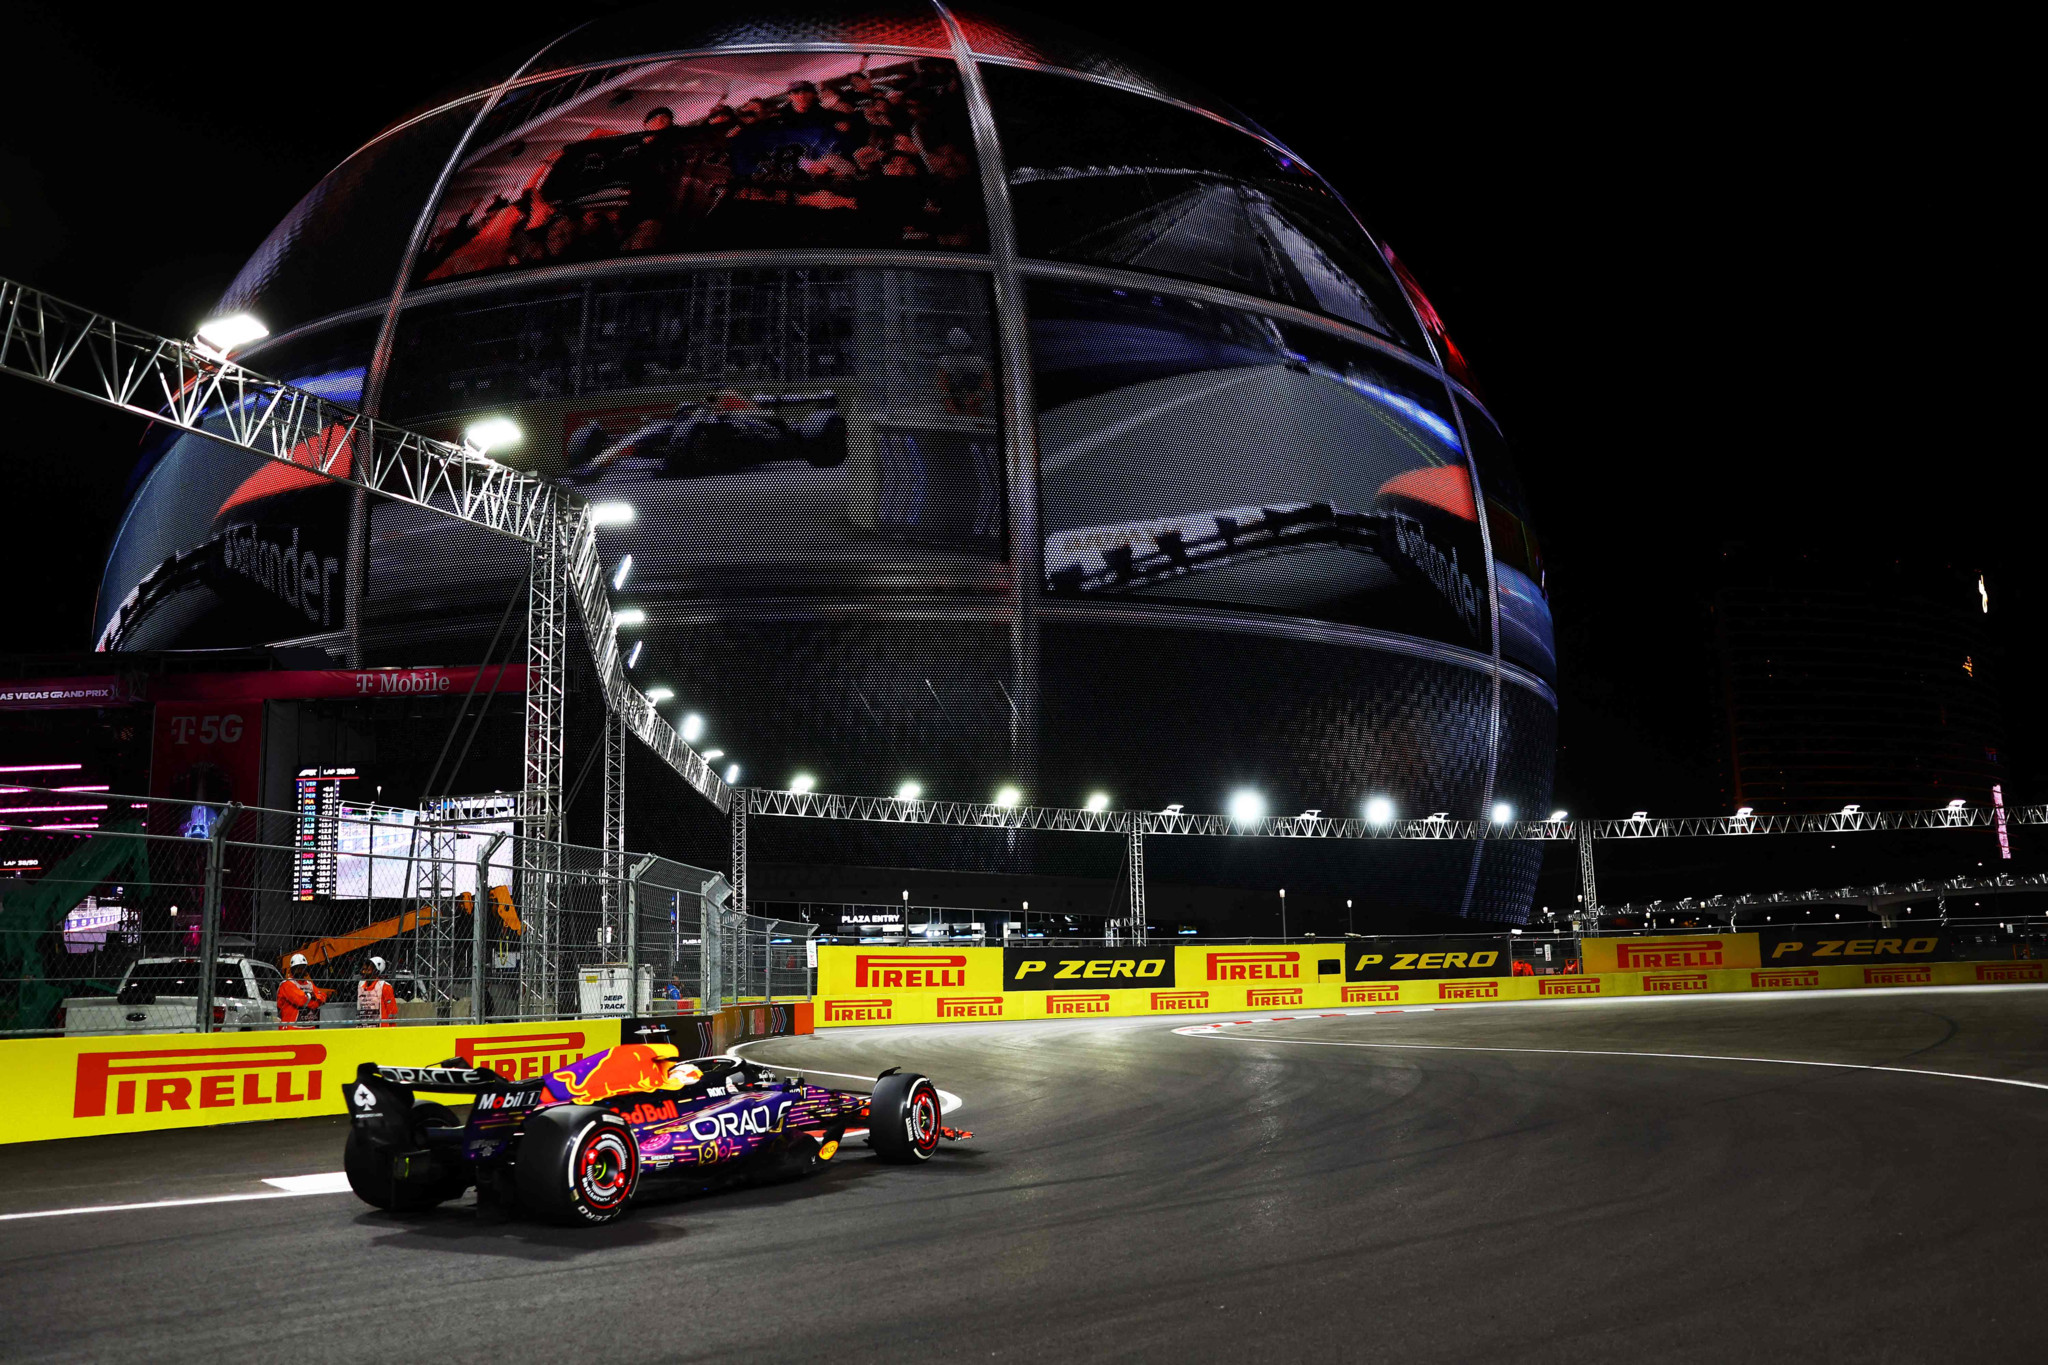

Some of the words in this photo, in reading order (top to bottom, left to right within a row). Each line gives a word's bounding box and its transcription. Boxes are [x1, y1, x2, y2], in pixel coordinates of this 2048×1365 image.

[356, 673, 373, 694] T
[379, 671, 450, 694] Mobile
[15, 691, 50, 700] VEGAS
[50, 690, 85, 699] GRAND
[86, 689, 109, 697] PRIX
[199, 713, 244, 745] 5G
[841, 914, 870, 923] PLAZA
[871, 914, 900, 923] ENTRY
[1616, 940, 1724, 969] PIRELLI
[1771, 941, 1804, 959] P
[1811, 937, 1939, 957] ZERO
[855, 954, 967, 988] PIRELLI
[1015, 960, 1046, 980] P
[1054, 958, 1167, 979] ZERO
[1206, 951, 1301, 980] PIRELLI
[1355, 954, 1383, 971] P
[1389, 950, 1499, 970] ZERO
[1751, 971, 1819, 988] PIRELLI
[1864, 966, 1931, 984] PIRELLI
[1976, 963, 2043, 981] PIRELLI
[1341, 984, 1400, 1003] PIRELLI
[1439, 981, 1499, 999] PIRELLI
[1539, 977, 1600, 995] PIRELLI
[1643, 974, 1707, 992] PIRELLI
[936, 996, 1004, 1018] PIRELLI
[1046, 993, 1110, 1014] PIRELLI
[1150, 990, 1208, 1011] PIRELLI
[1246, 987, 1303, 1007] PIRELLI
[824, 999, 893, 1021] PIRELLI
[455, 1032, 585, 1081] PREL
[73, 1043, 327, 1118] PIRELLI
[379, 1067, 481, 1085] ORACLE
[477, 1091, 525, 1110] Mobil
[706, 1086, 727, 1098] ROKT
[642, 1099, 679, 1123] Bull
